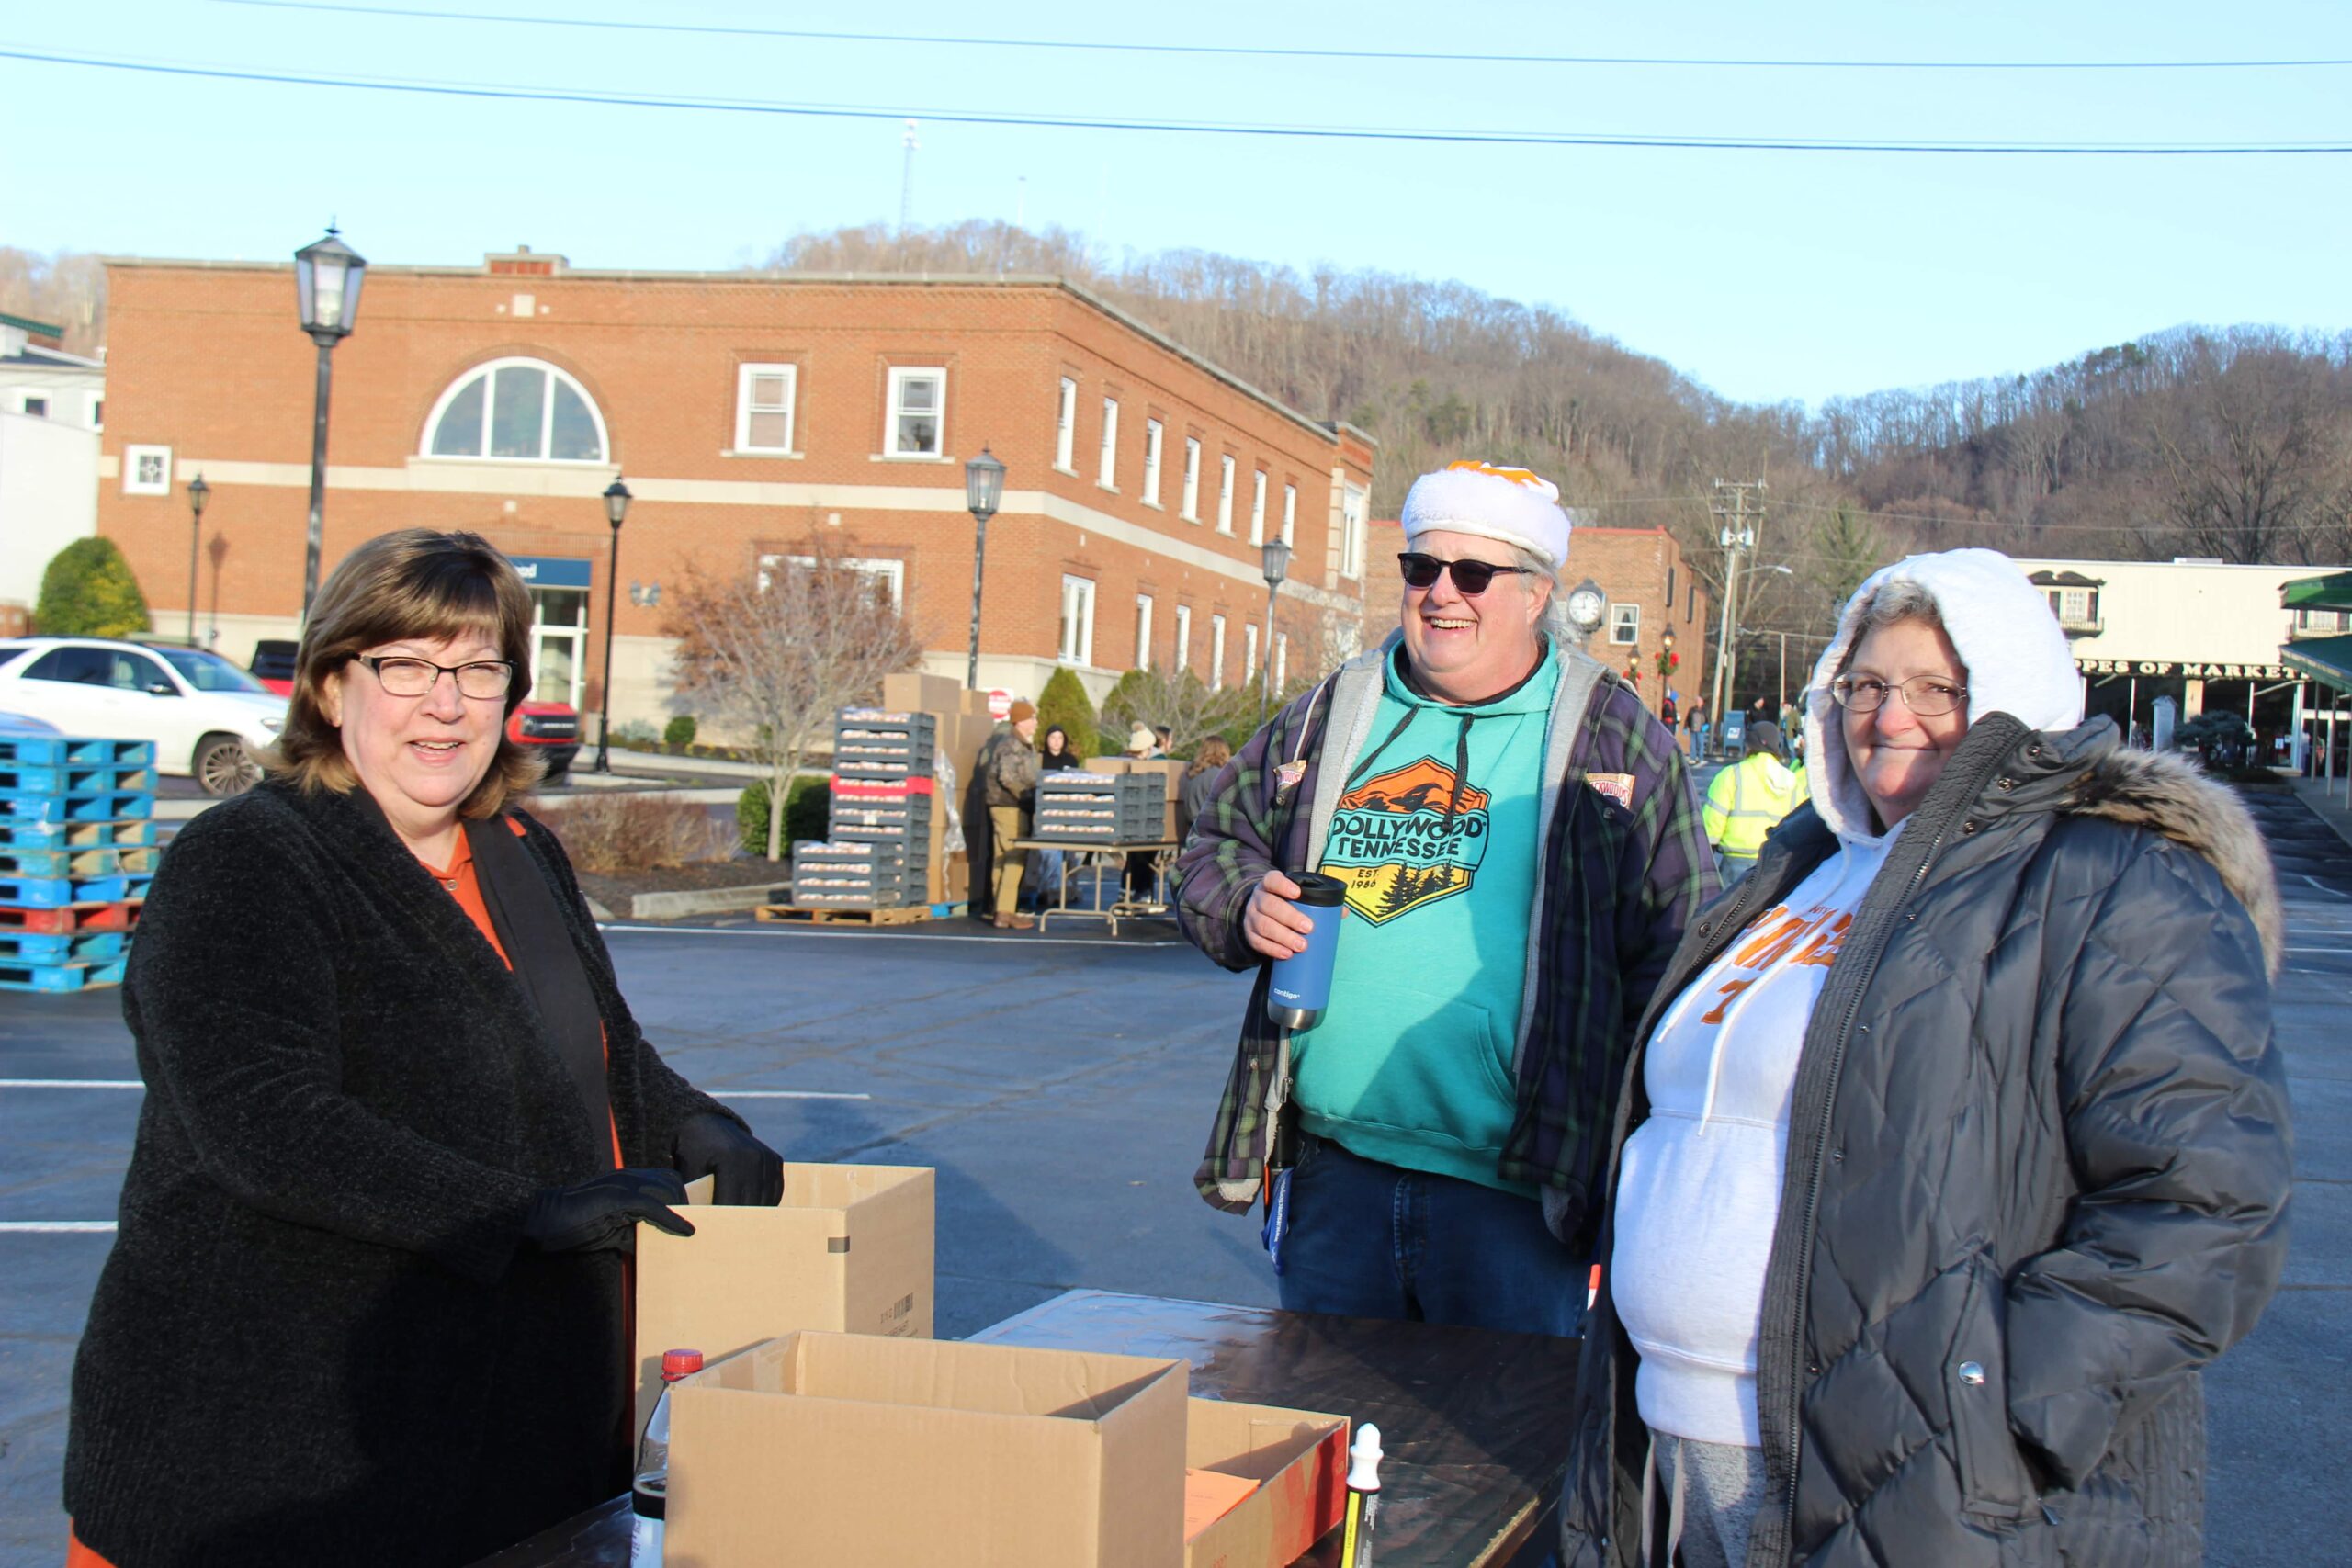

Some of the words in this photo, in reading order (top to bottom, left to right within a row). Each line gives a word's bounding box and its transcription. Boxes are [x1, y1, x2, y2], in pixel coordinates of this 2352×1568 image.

[2139, 661, 2173, 675] OF
[1333, 816, 1483, 840] DOLLYWOOD
[1338, 837, 1462, 860] TENNESSEE
[1351, 879, 1376, 889] 1986
